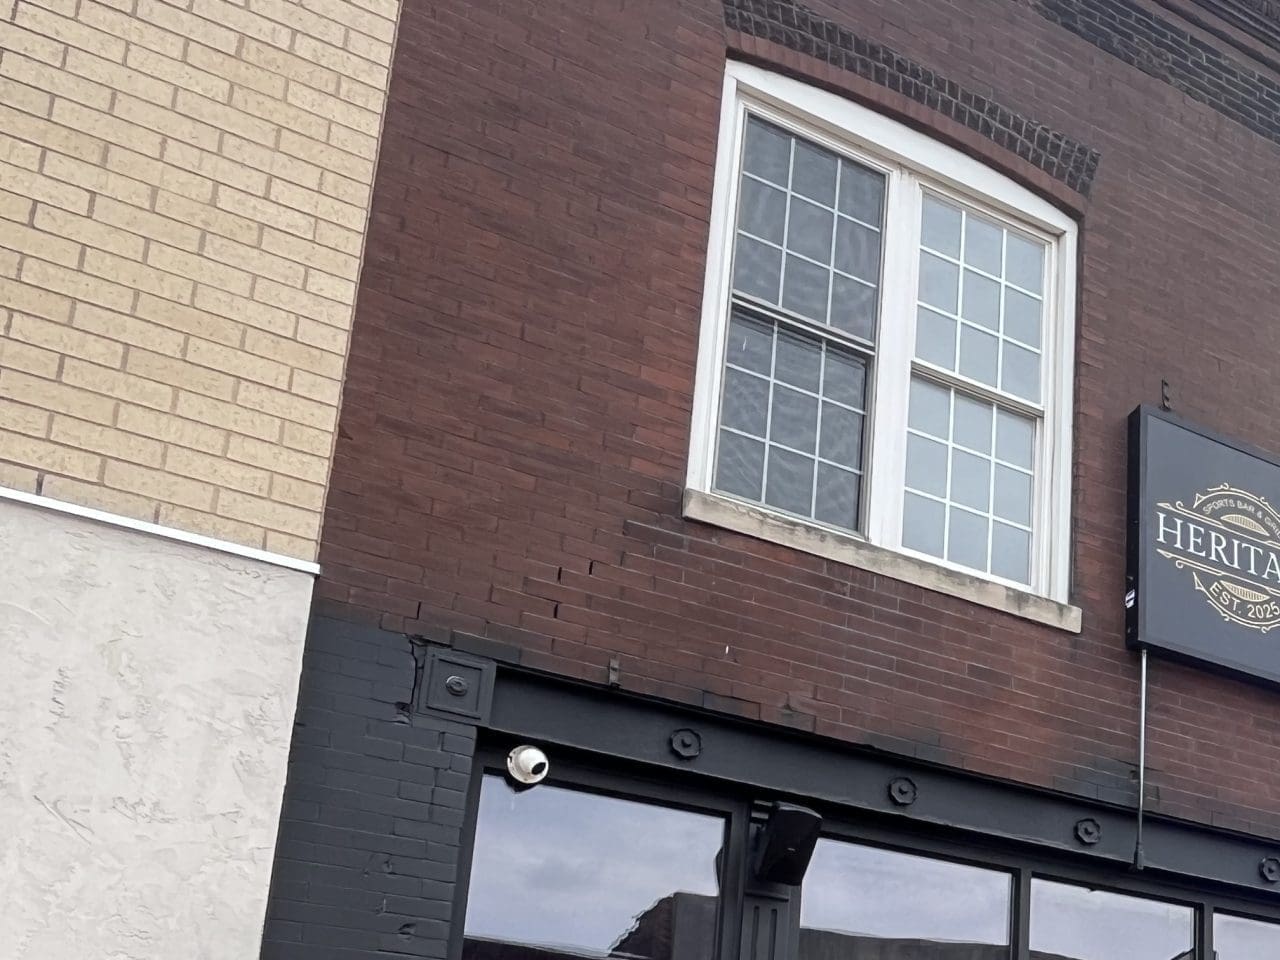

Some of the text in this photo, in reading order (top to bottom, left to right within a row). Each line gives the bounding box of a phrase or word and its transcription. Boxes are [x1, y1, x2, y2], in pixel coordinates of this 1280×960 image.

[1202, 498, 1236, 515] SPORTS
[1236, 500, 1255, 515] BAR
[1256, 510, 1263, 519] &
[1209, 581, 1280, 619] EST. 2025
